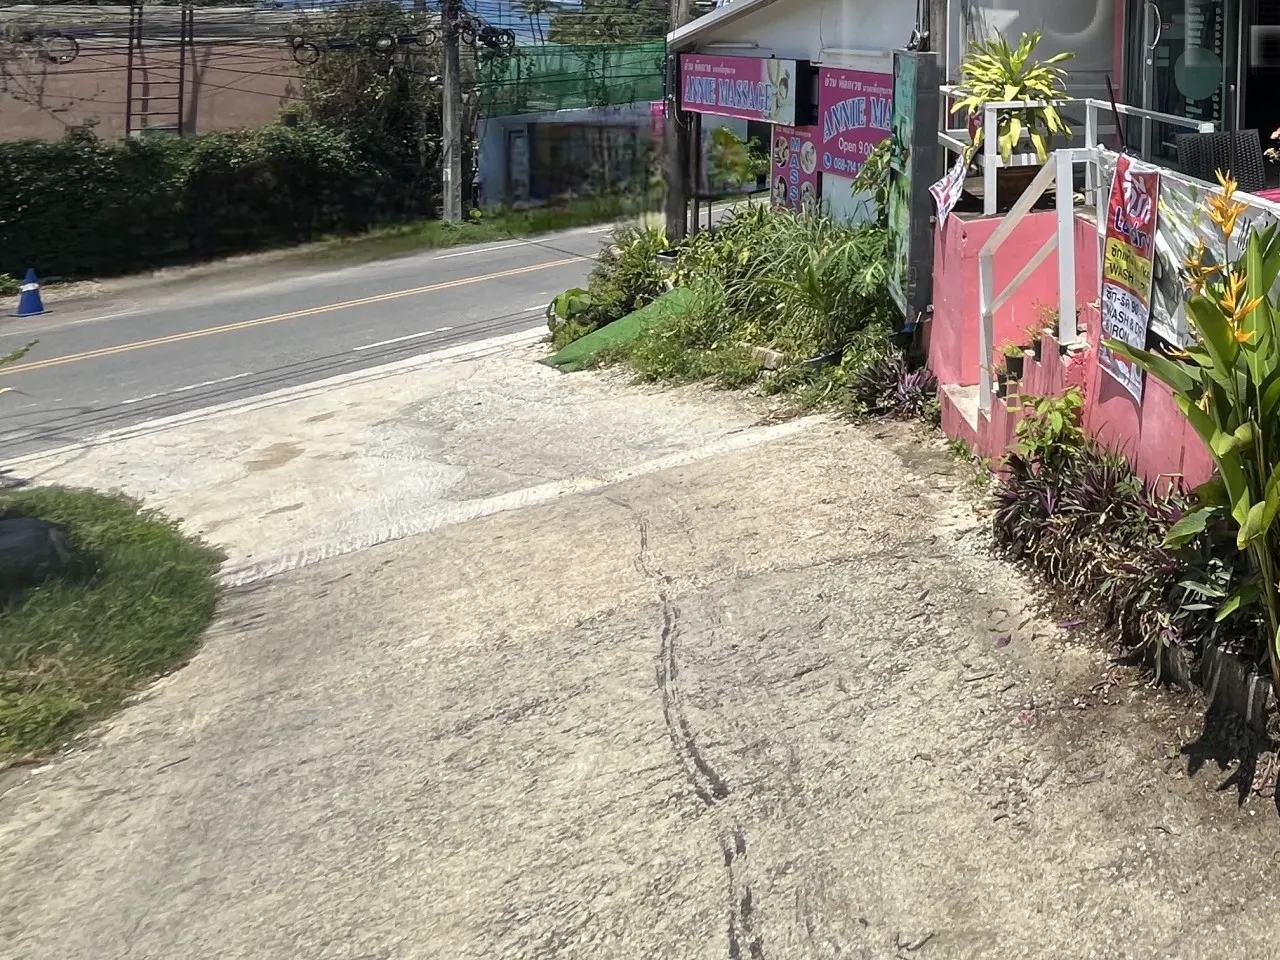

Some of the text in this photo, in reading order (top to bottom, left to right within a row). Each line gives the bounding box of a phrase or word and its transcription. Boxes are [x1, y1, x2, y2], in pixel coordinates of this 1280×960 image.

[684, 76, 772, 113] ANNIE MASSAGE
[823, 97, 866, 144] ANNIE
[838, 137, 857, 153] Open
[1109, 263, 1133, 284] WASH
[1106, 304, 1129, 327] WASH
